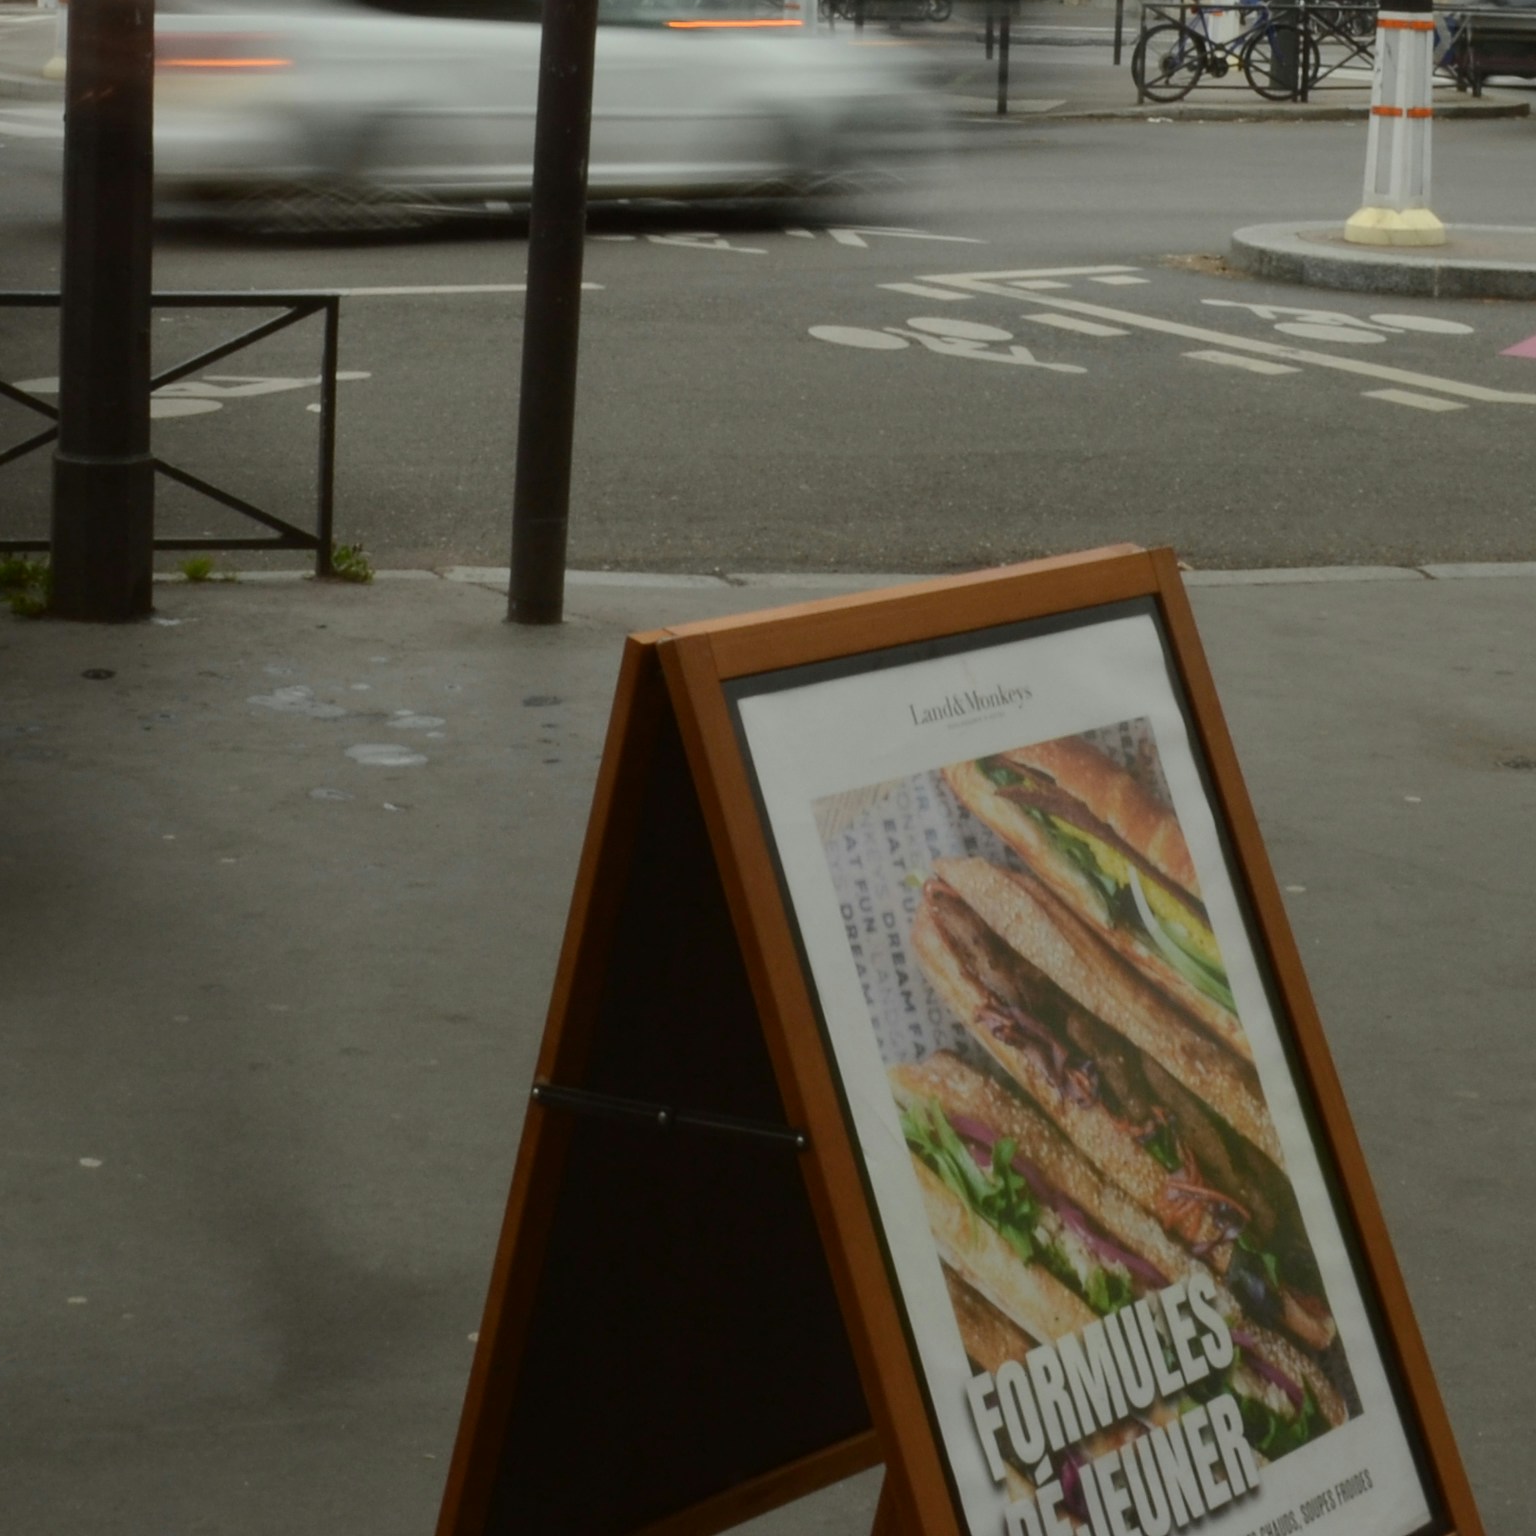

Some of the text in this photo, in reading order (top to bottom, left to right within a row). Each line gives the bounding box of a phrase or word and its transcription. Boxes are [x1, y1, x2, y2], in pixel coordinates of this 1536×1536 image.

[882, 912, 918, 1013] DREAM
[966, 1272, 1236, 1483] FORMULES
[1300, 1488, 1337, 1525] SOUPES
[1335, 1467, 1375, 1511] FROIDES
